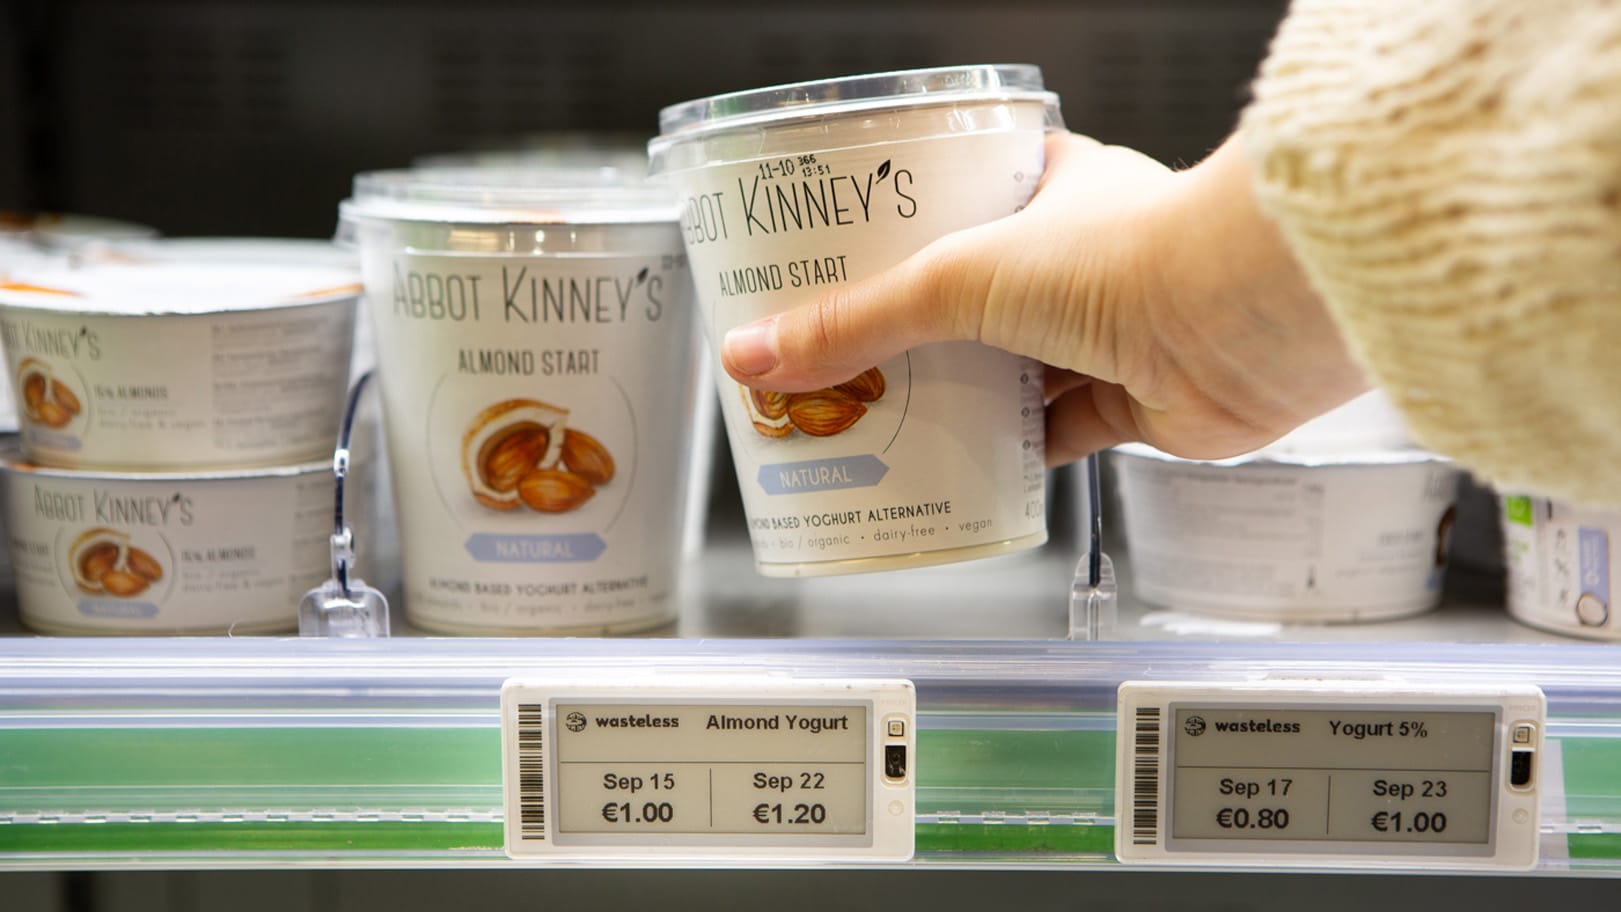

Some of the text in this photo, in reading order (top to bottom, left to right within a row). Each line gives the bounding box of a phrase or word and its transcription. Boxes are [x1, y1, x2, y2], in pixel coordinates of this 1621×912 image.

[758, 158, 795, 180] 11-10
[801, 164, 831, 178] 13:51
[738, 159, 917, 236] KINNEY'S
[719, 255, 848, 297] ALMOND START
[392, 259, 663, 323] ABBOT KINNEY'S
[457, 348, 600, 376] ALMOND START
[778, 464, 852, 489] NATURAL
[34, 484, 195, 526] ABBOT KINNEY'S
[771, 516, 800, 530] BASED
[803, 511, 862, 528] YOGHURT
[867, 500, 952, 522] ALTERNATIVE
[807, 532, 850, 549] organic
[873, 525, 936, 543] dairy-free
[958, 517, 993, 533] vegan
[495, 540, 574, 559] NATURAL
[475, 580, 513, 596] BASED
[517, 583, 577, 598] YOGHURT
[595, 713, 849, 734] wasteless Almond Yogurt
[1215, 718, 1428, 740] wasteless Yogurt 5%
[603, 773, 675, 794] Sep 15
[753, 772, 825, 793] Sep 22
[1219, 778, 1293, 799] Sep 17
[1373, 779, 1448, 800] Sep 23
[601, 802, 674, 824] €1.00
[752, 803, 826, 825] €1.20
[1216, 808, 1290, 830] €0.80
[1371, 811, 1447, 833] €1.00
